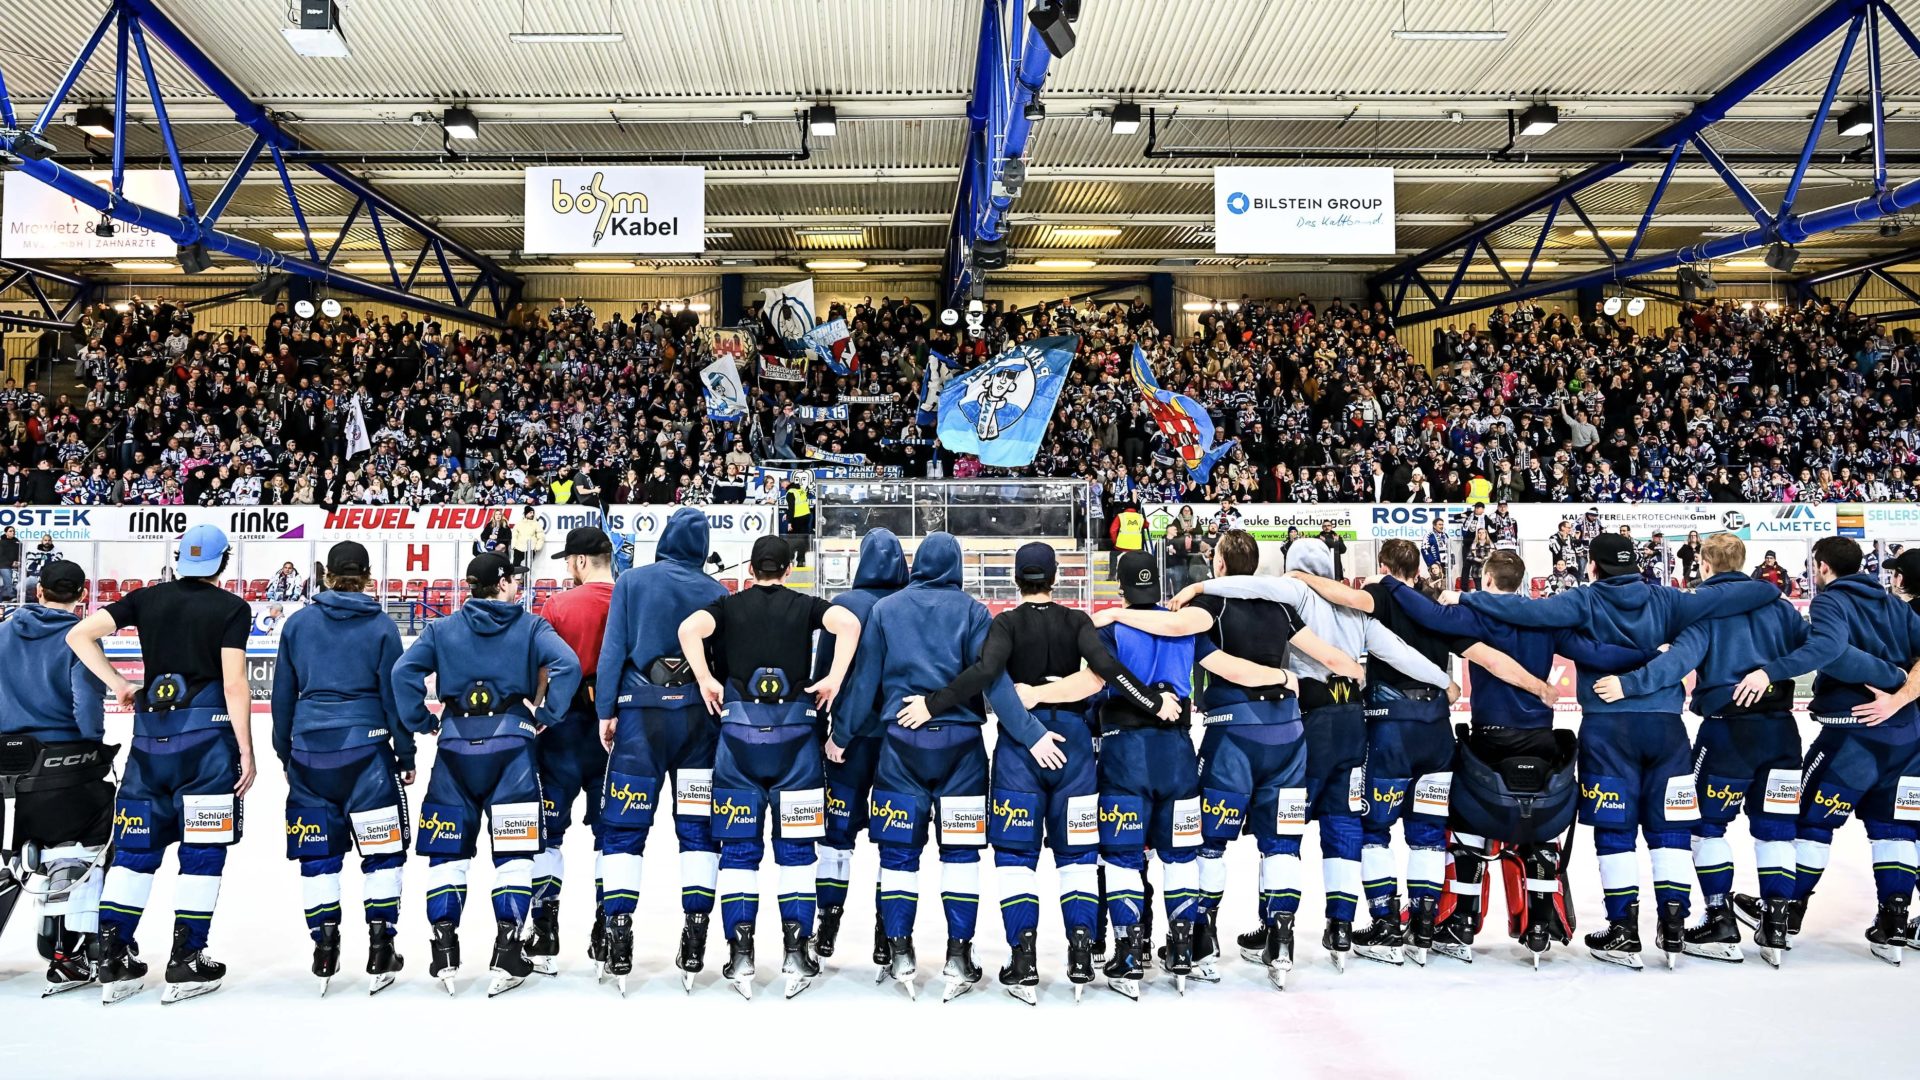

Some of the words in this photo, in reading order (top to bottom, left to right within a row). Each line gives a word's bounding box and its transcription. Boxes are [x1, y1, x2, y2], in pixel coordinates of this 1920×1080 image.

[1254, 198, 1322, 210] BILSTEIN
[1327, 198, 1383, 210] GROUP
[84, 221, 96, 234] &
[611, 217, 678, 236] Kabel
[832, 406, 847, 419] 15
[324, 509, 415, 530] HEUEL
[1243, 514, 1270, 526] euke
[1372, 507, 1473, 524] ROSTE
[1868, 509, 1920, 521] SEILERS
[129, 508, 187, 533] rinke
[231, 508, 289, 533] rinke
[1756, 521, 1832, 532] ALMETEC
[0, 528, 91, 539] ächentechnik
[406, 544, 430, 572] H
[1116, 674, 1155, 709] WARRIOR
[43, 750, 99, 768] CCM
[689, 785, 711, 793] Schlü
[1428, 785, 1448, 794] Schlü
[677, 791, 711, 801] Systems
[1415, 790, 1448, 801] Systems
[629, 802, 652, 810] Kabel
[1602, 801, 1626, 809] Kabel
[198, 811, 233, 821] Schlüter
[828, 807, 850, 817] Kabel
[954, 813, 985, 821] Schlüter
[185, 819, 221, 828] Systems
[504, 820, 538, 828] Schlüter
[733, 816, 757, 824] Kabel
[781, 814, 815, 824] Systems
[890, 819, 913, 829] Kabel
[1011, 819, 1034, 827] Kabel
[126, 826, 150, 834] Kabel
[366, 822, 399, 834] Schlüter
[942, 820, 976, 830] Systems
[1122, 822, 1144, 831] Kabel
[358, 832, 389, 842] Systems
[438, 832, 462, 840] Kabel
[493, 828, 526, 837] Systems
